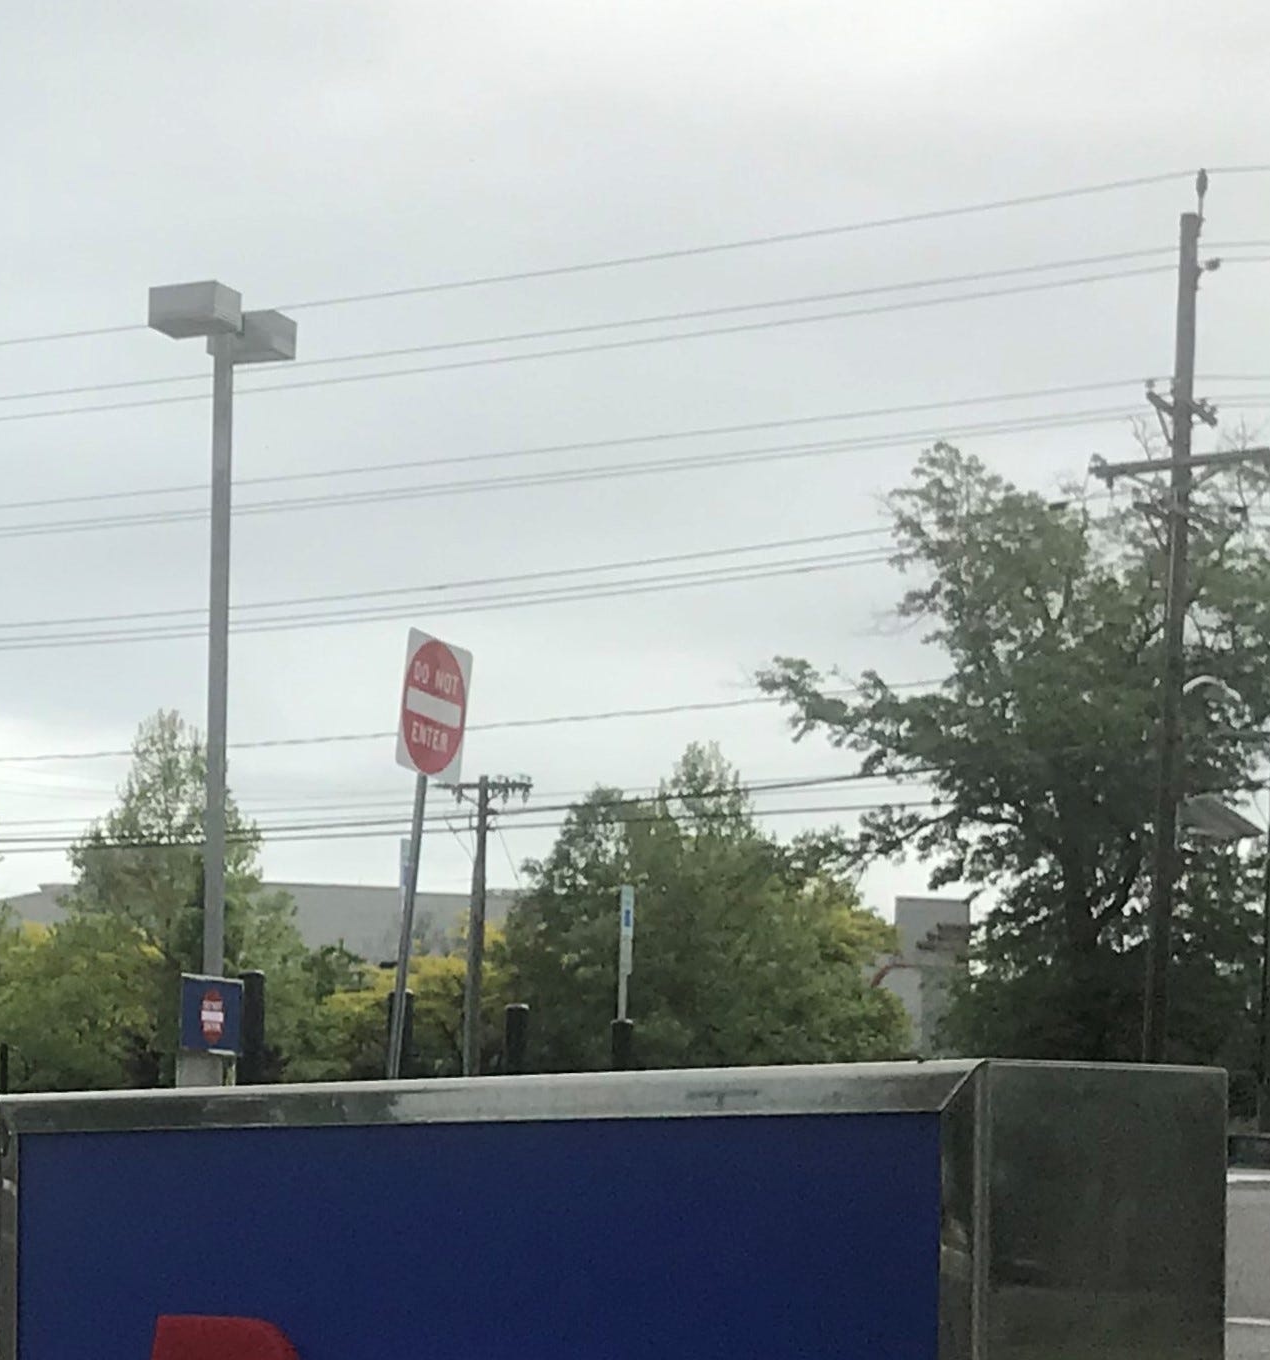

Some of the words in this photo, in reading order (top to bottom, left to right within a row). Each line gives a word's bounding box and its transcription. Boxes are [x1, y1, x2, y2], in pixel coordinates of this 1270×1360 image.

[415, 661, 429, 684] DO
[435, 671, 460, 695] NOT
[412, 721, 448, 753] ENTER
